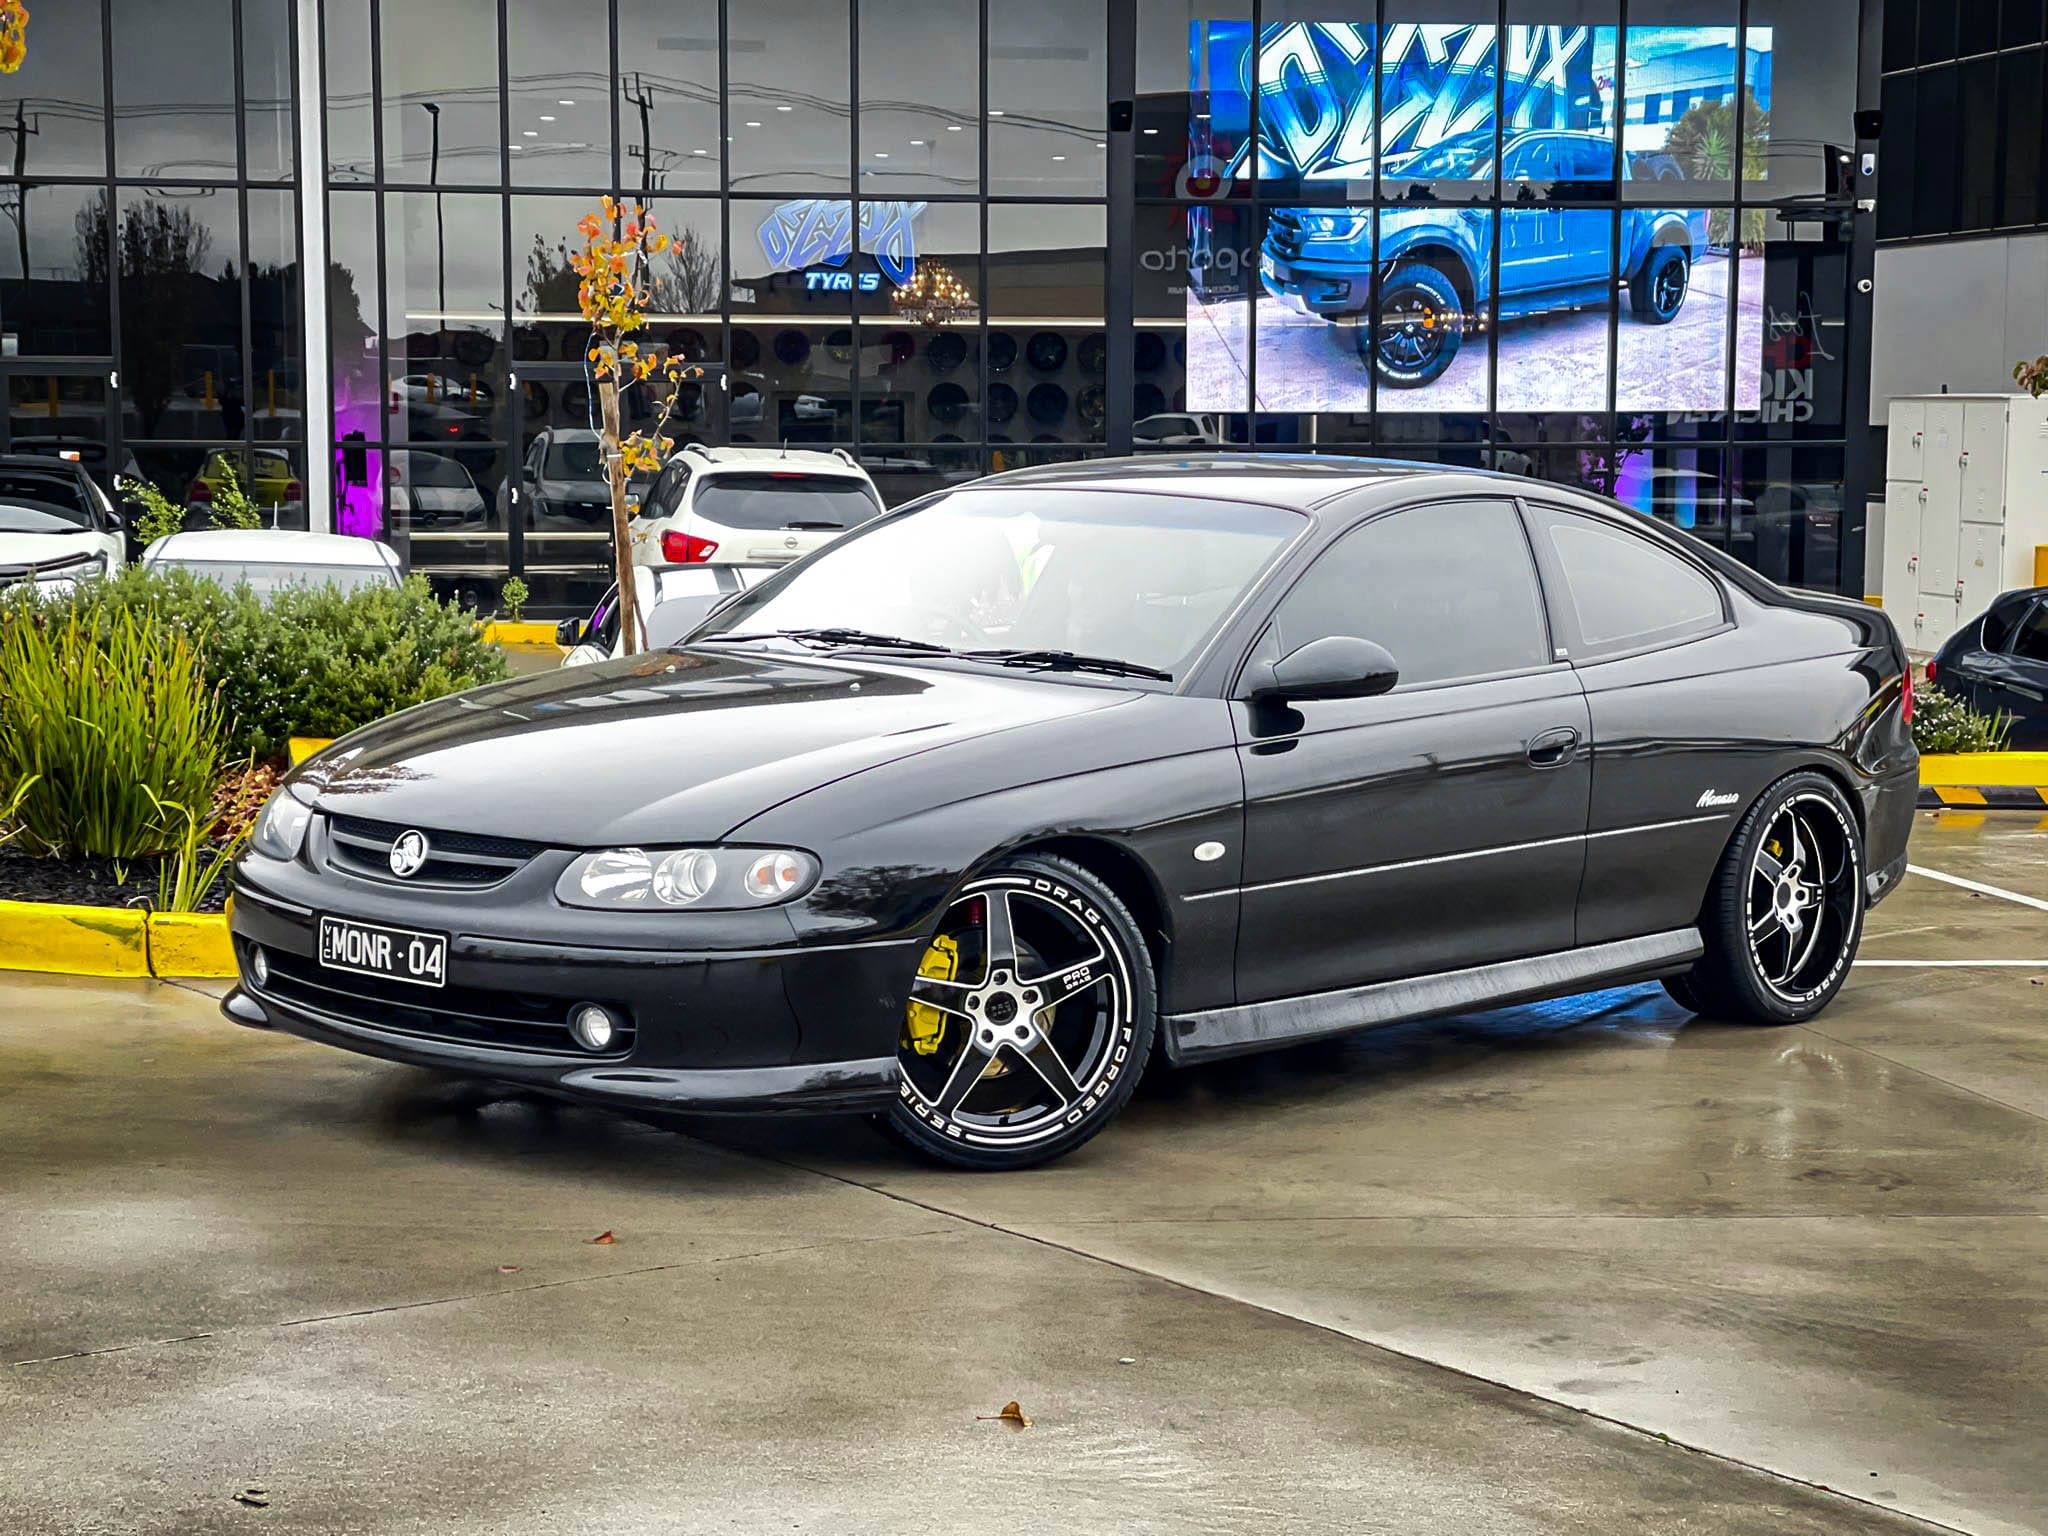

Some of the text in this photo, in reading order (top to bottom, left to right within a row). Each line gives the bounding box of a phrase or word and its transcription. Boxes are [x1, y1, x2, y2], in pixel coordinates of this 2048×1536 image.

[1034, 878, 1100, 924] DRAG
[323, 925, 332, 959] VIC
[332, 926, 442, 979] MONR 04
[1062, 966, 1091, 985] PRO
[1065, 974, 1093, 991] DRAG
[1066, 1025, 1133, 1124] FORGED
[900, 1081, 962, 1138] SERIE
